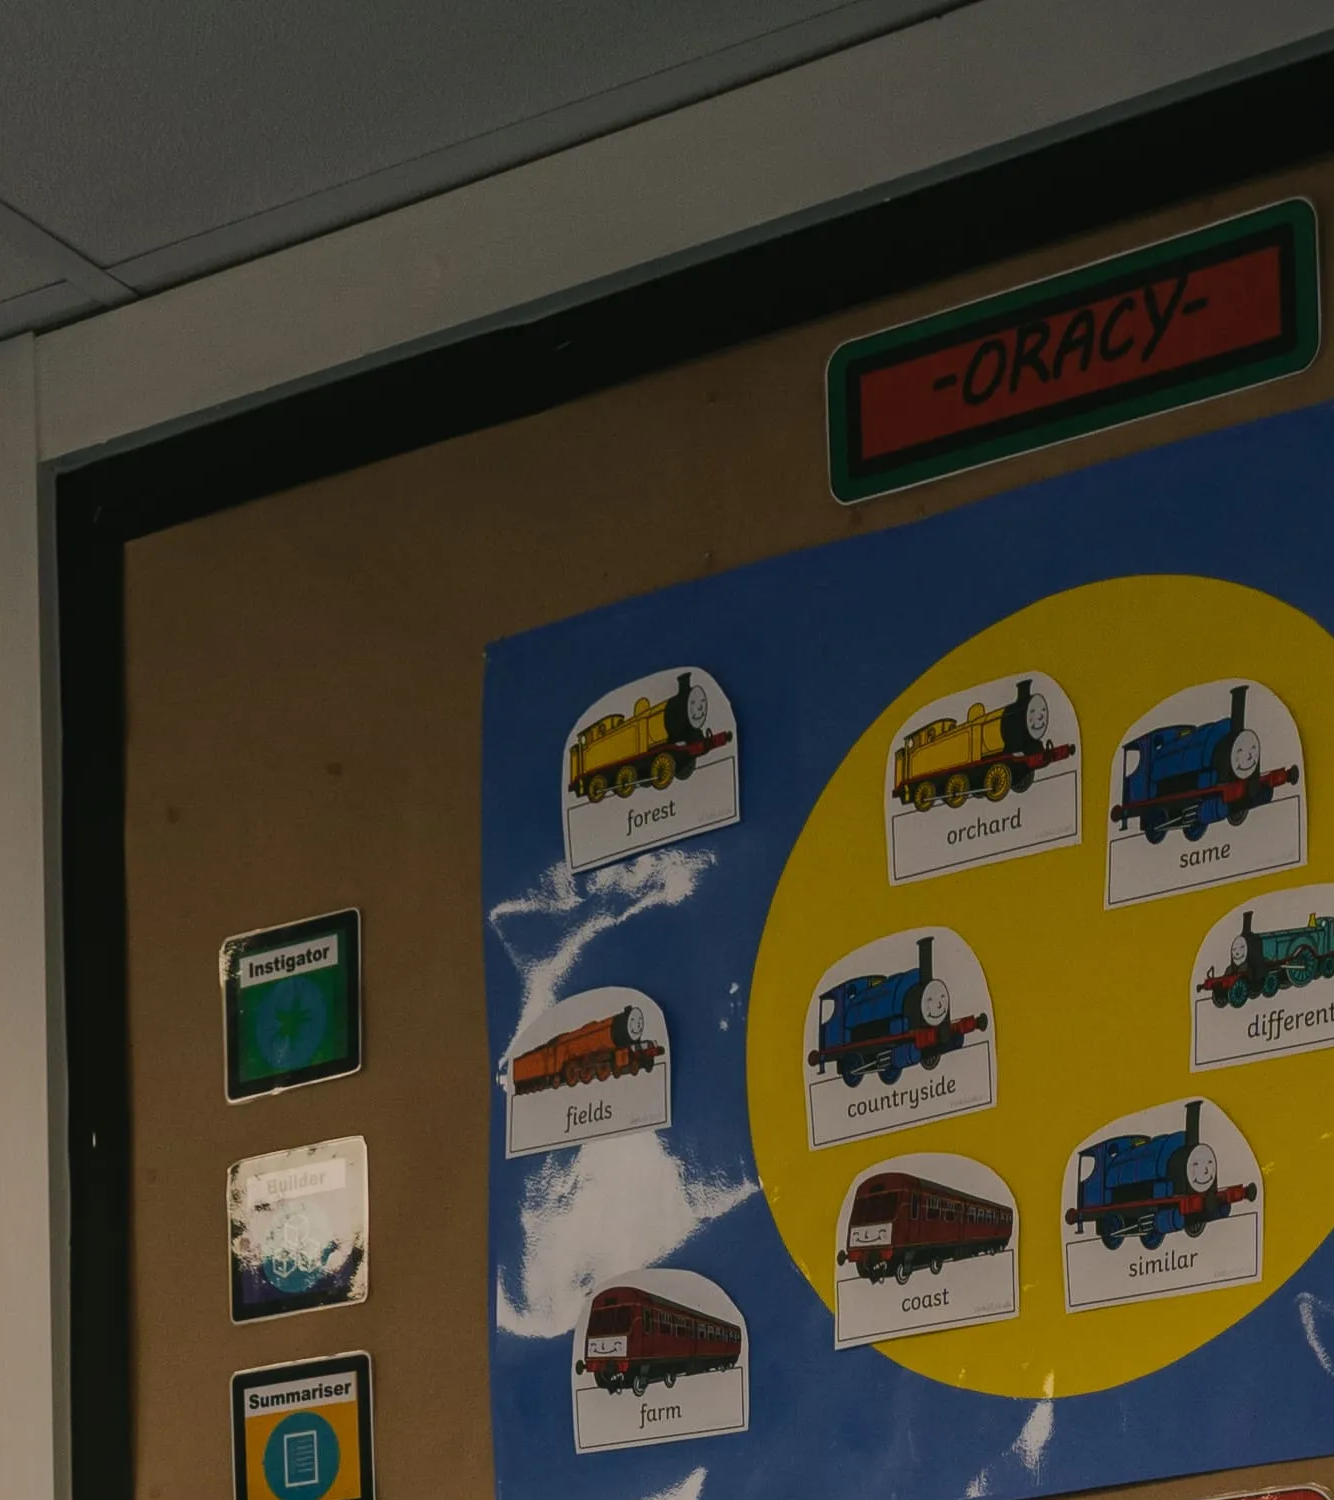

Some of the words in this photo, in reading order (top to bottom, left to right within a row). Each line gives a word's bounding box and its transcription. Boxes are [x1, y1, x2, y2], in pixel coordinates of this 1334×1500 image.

[627, 800, 676, 835] forest
[946, 809, 1022, 845] orchard
[1178, 841, 1231, 869] same
[249, 946, 330, 979] Instigator
[846, 1073, 957, 1119] countryside
[565, 1101, 613, 1132] fields
[267, 1172, 325, 1195] Builder
[1127, 1247, 1198, 1279] similar
[901, 1288, 950, 1313] coast
[249, 1382, 352, 1410] Summariser
[639, 1403, 683, 1429] farm
